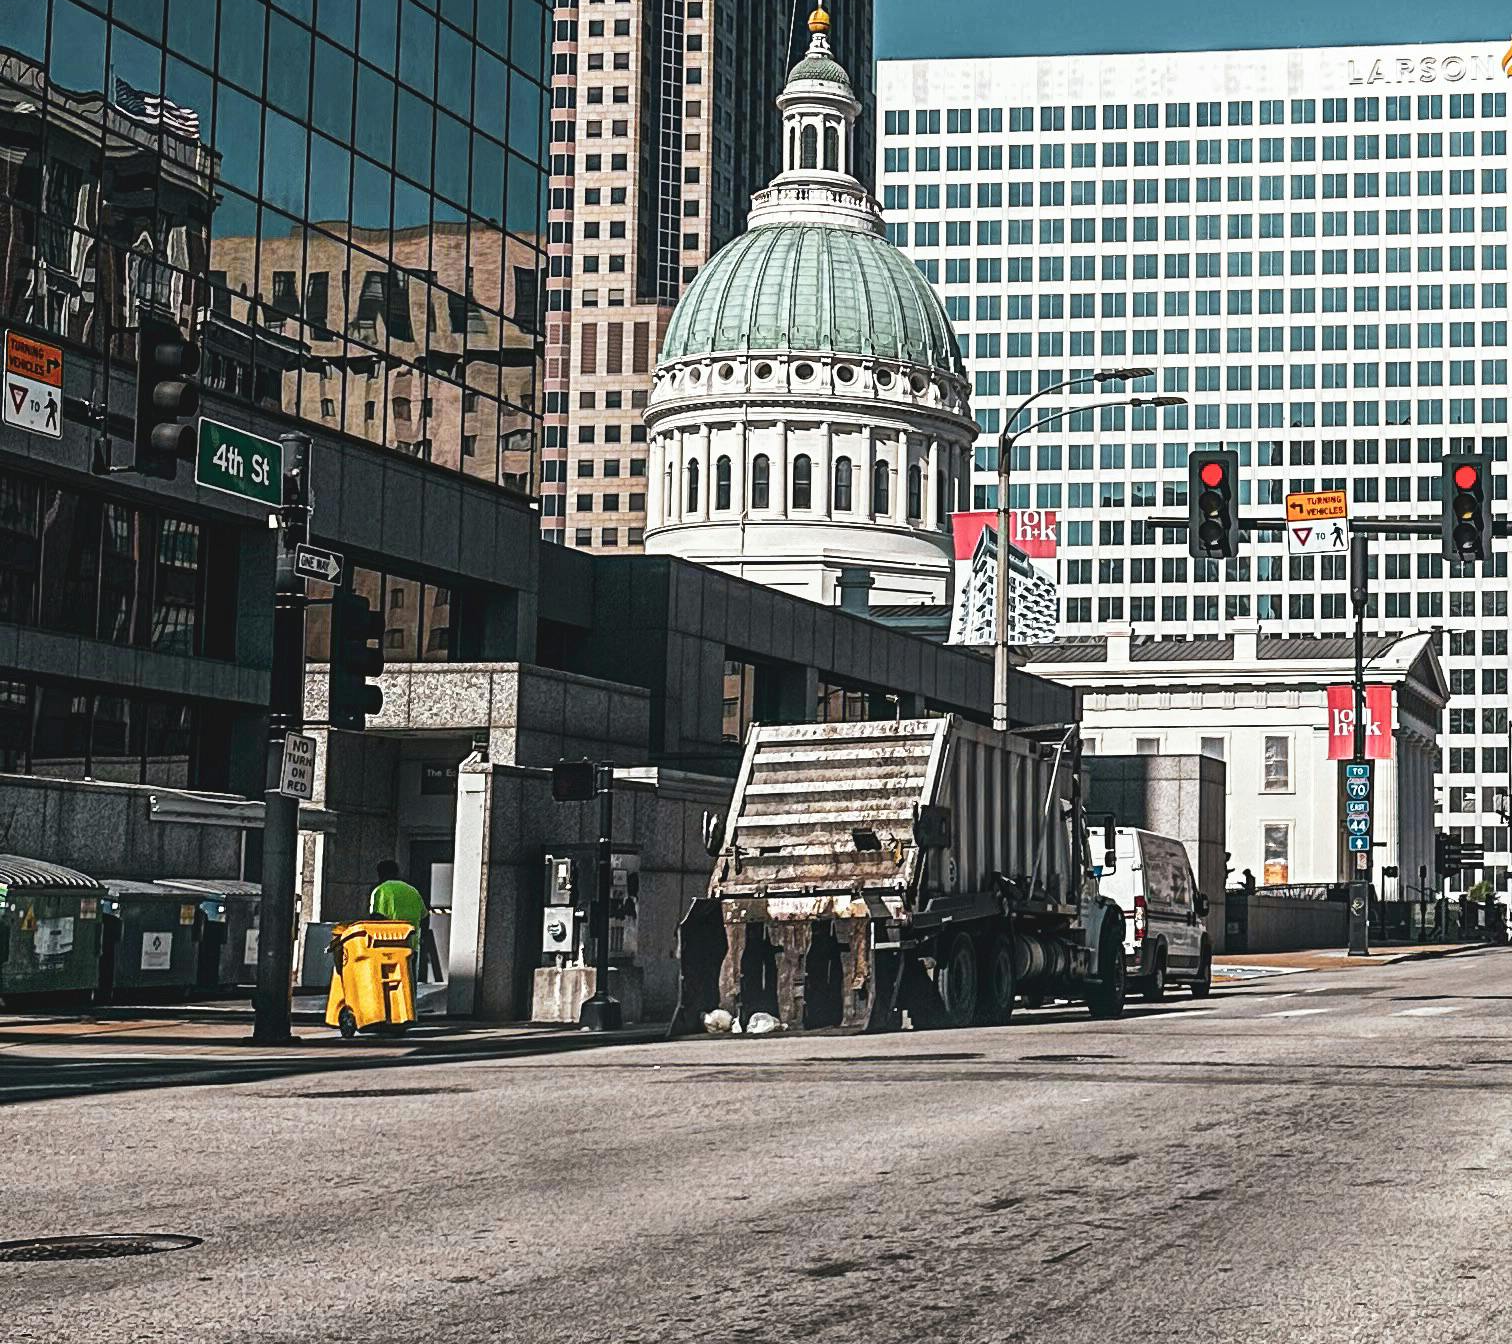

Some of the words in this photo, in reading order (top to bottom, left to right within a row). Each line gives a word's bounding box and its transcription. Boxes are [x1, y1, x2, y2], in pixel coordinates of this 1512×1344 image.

[1347, 55, 1495, 85] LARSON
[10, 337, 45, 359] TURNING
[30, 399, 40, 413] TO
[212, 443, 244, 478] 4th
[251, 454, 270, 486] St
[1306, 495, 1342, 505] TURNING
[1306, 506, 1344, 516] VEHICLES
[1315, 532, 1326, 540] TO
[292, 740, 309, 754] NO
[287, 752, 313, 767] TURN
[291, 767, 306, 779] ON
[1352, 767, 1364, 775] TO
[286, 780, 307, 793] RED
[1350, 784, 1366, 796] 70
[1350, 819, 1366, 831] 44
